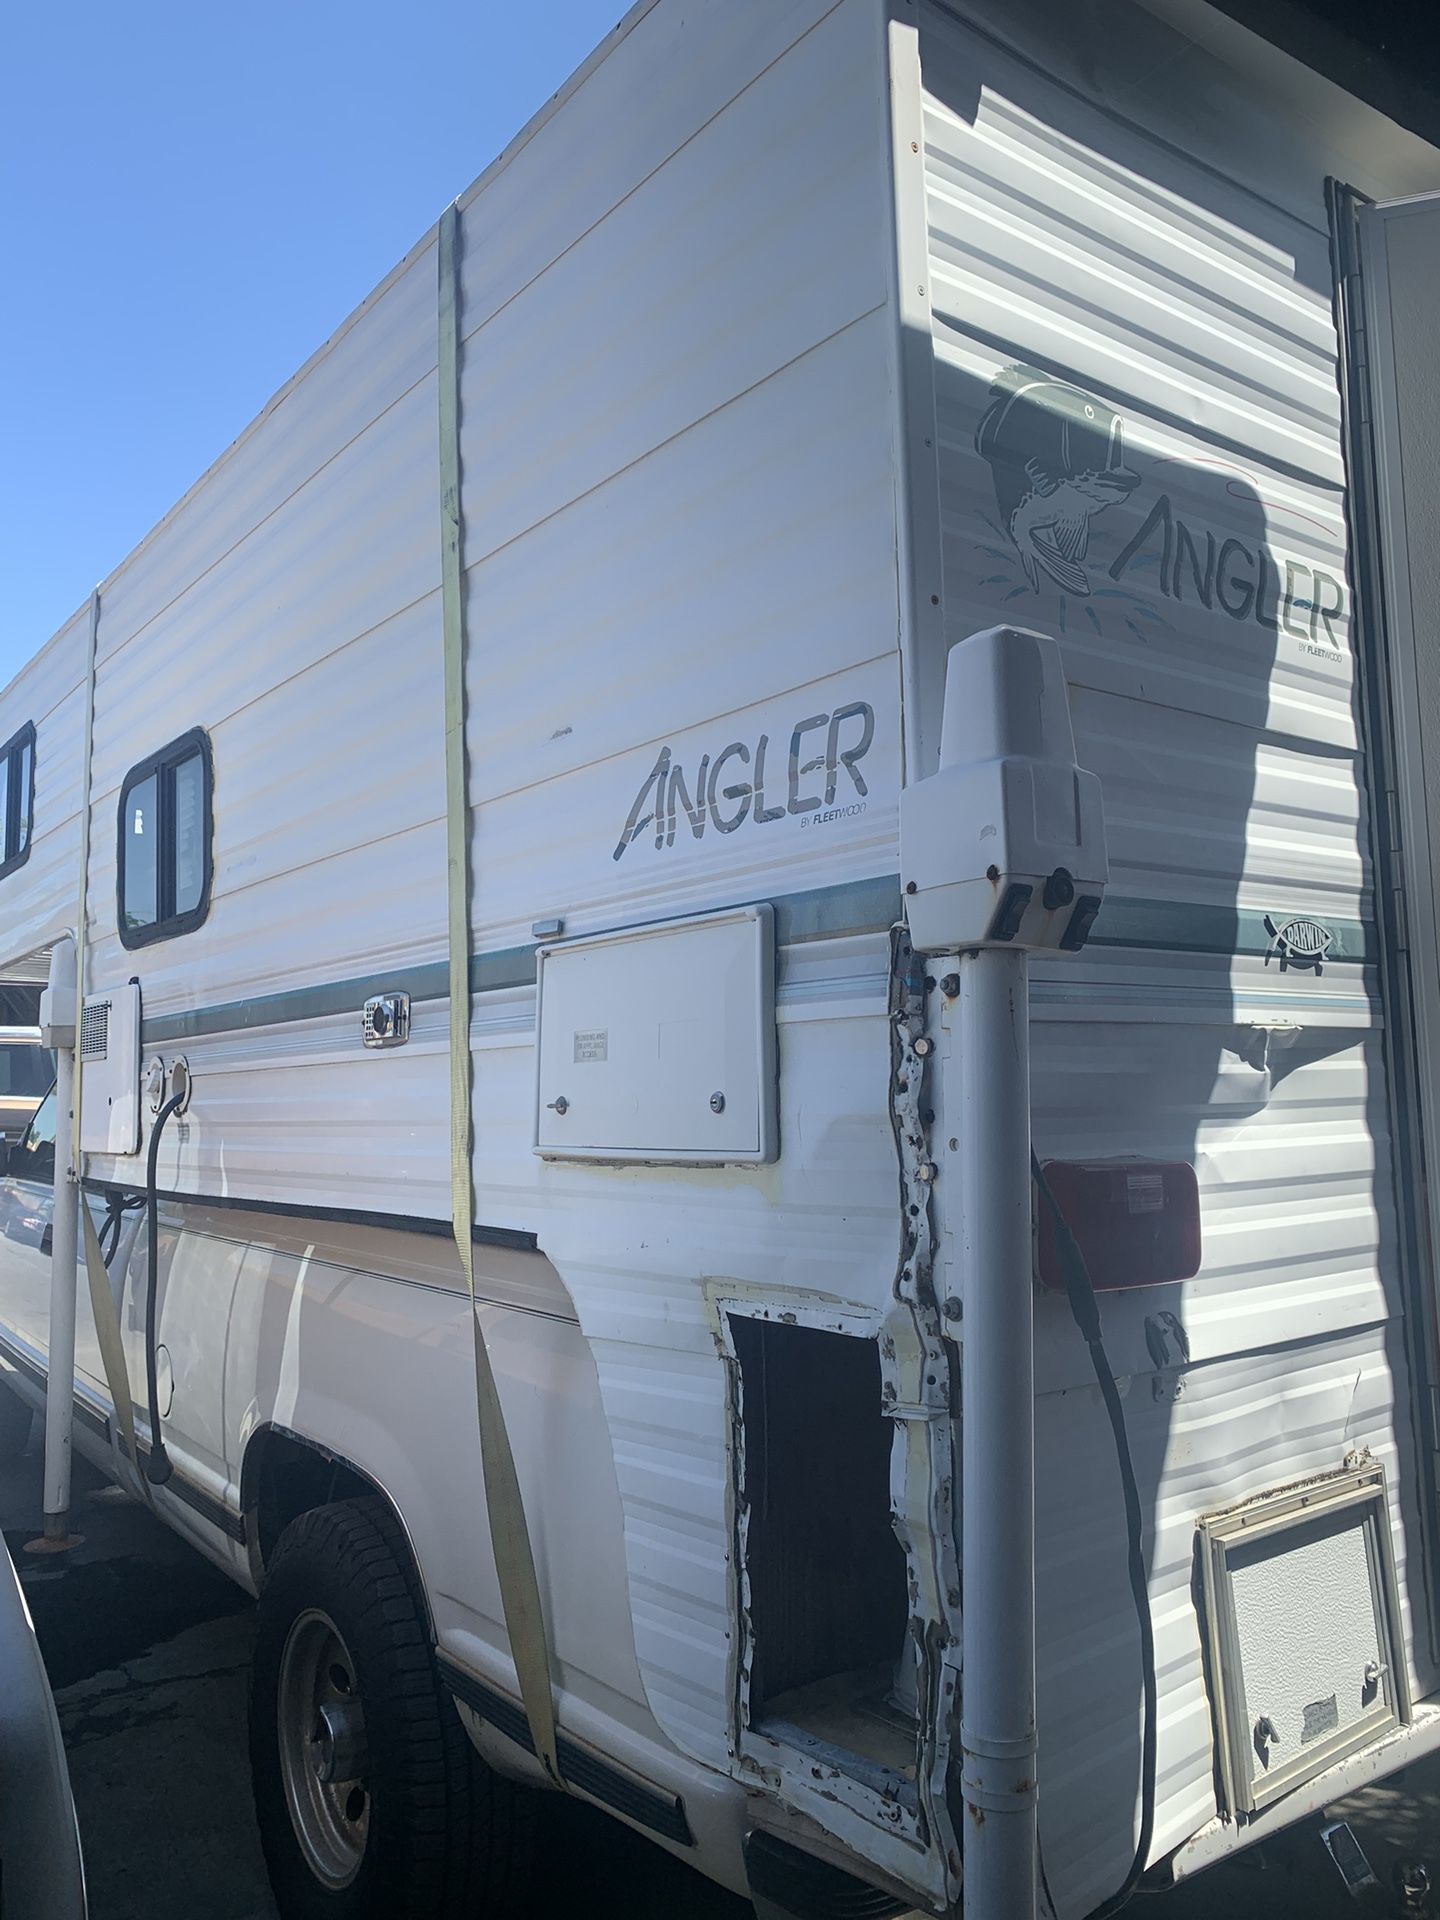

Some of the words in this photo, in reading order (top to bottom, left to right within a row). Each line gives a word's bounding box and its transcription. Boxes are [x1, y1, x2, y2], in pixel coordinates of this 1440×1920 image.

[1109, 494, 1345, 649] ANGLER
[1298, 642, 1306, 653] BY
[1307, 645, 1342, 662] FLEETWOOD
[612, 701, 875, 862] ANGLER
[800, 816, 810, 829] BY
[812, 802, 867, 825] FLEETWOOD
[1287, 922, 1326, 950] DARWIN
